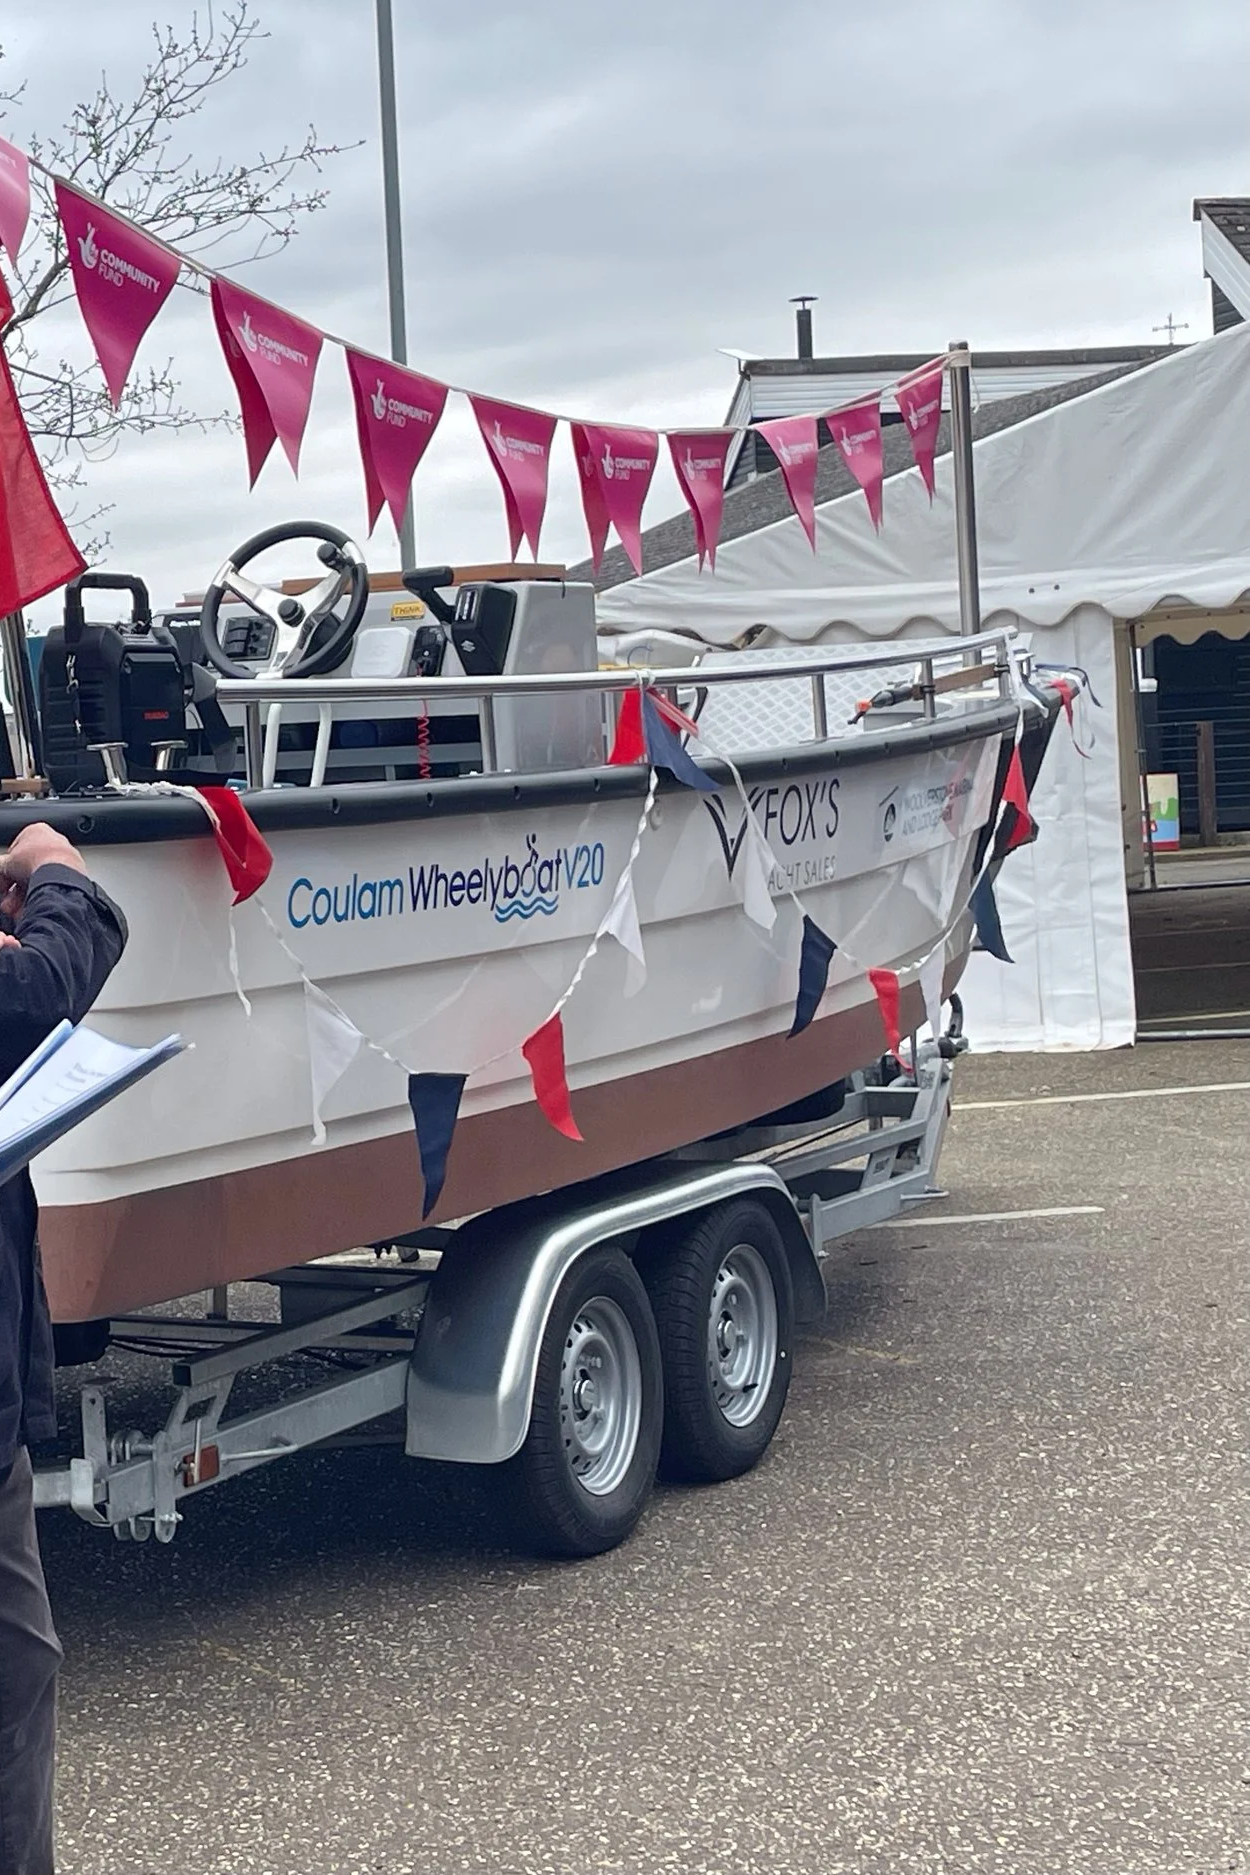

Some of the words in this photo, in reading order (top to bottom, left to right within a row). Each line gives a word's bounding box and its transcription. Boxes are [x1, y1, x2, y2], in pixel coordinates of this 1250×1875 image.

[98, 263, 124, 287] FUND
[100, 249, 161, 293] COMMUNITY
[257, 333, 308, 367] COMMUNITY
[259, 346, 281, 366] FUND
[387, 410, 406, 428] FUND
[388, 398, 433, 425] COMMUNITY
[764, 778, 840, 846] FOX'S
[287, 873, 403, 929] Coulam
[409, 848, 562, 911] Wheelyboat
[563, 842, 605, 889] V20
[767, 862, 801, 890] ACHT
[803, 855, 836, 886] SALES
